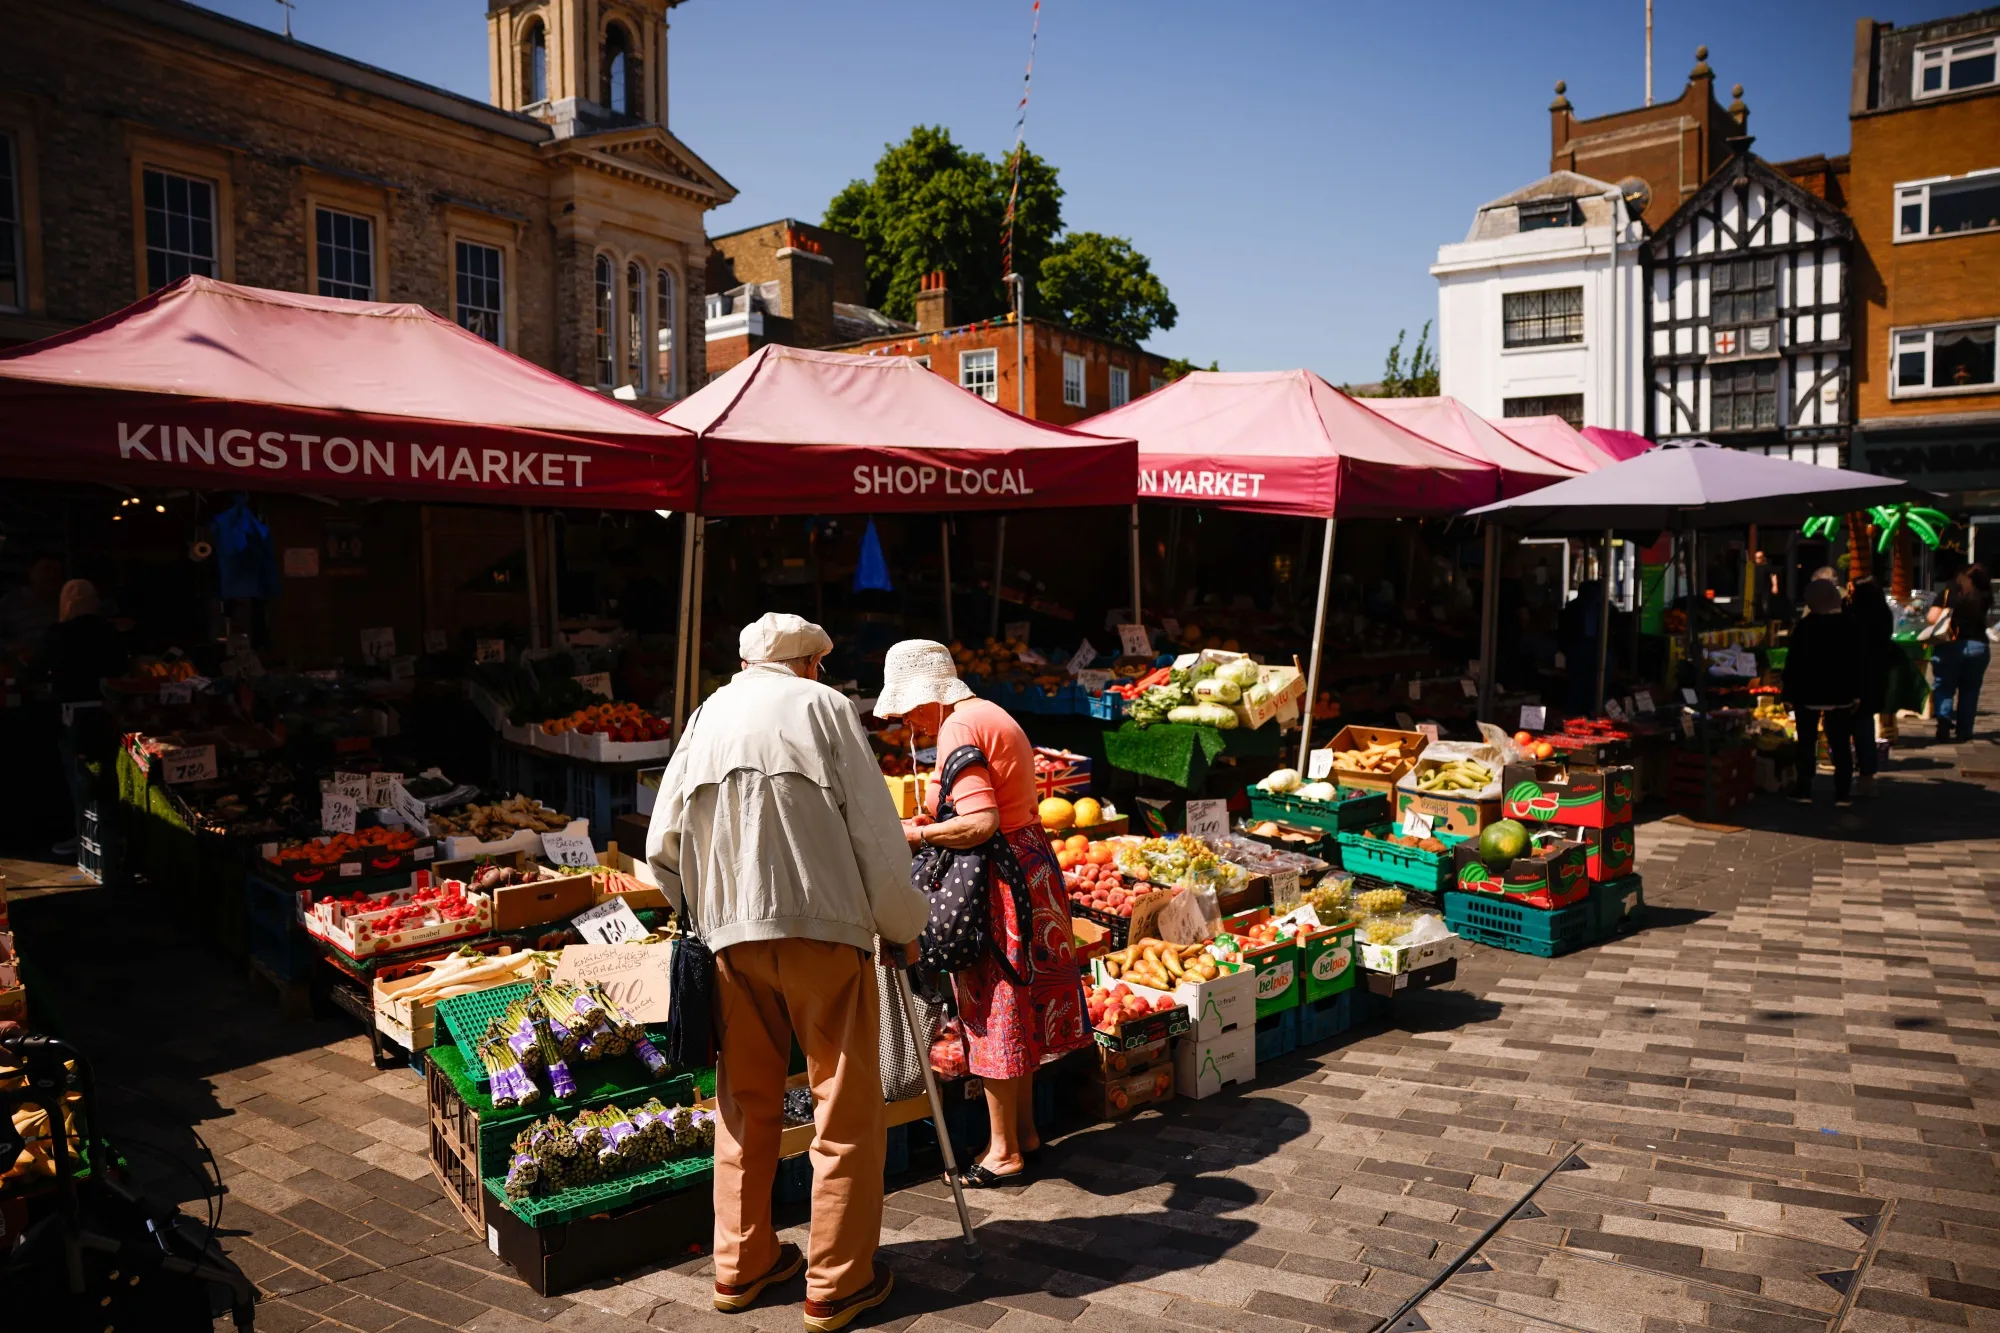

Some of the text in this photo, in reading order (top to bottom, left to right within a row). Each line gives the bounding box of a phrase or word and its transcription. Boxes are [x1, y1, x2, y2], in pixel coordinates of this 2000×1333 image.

[117, 421, 592, 488] KINGSTON MARKET
[853, 465, 1033, 495] SHOP LOCAL
[1138, 469, 1265, 498] N MARKET
[411, 929, 441, 941] tomabel
[574, 948, 650, 968] ENGLISH FRESH
[1319, 956, 1348, 976] belpas
[1259, 973, 1289, 994] belpas
